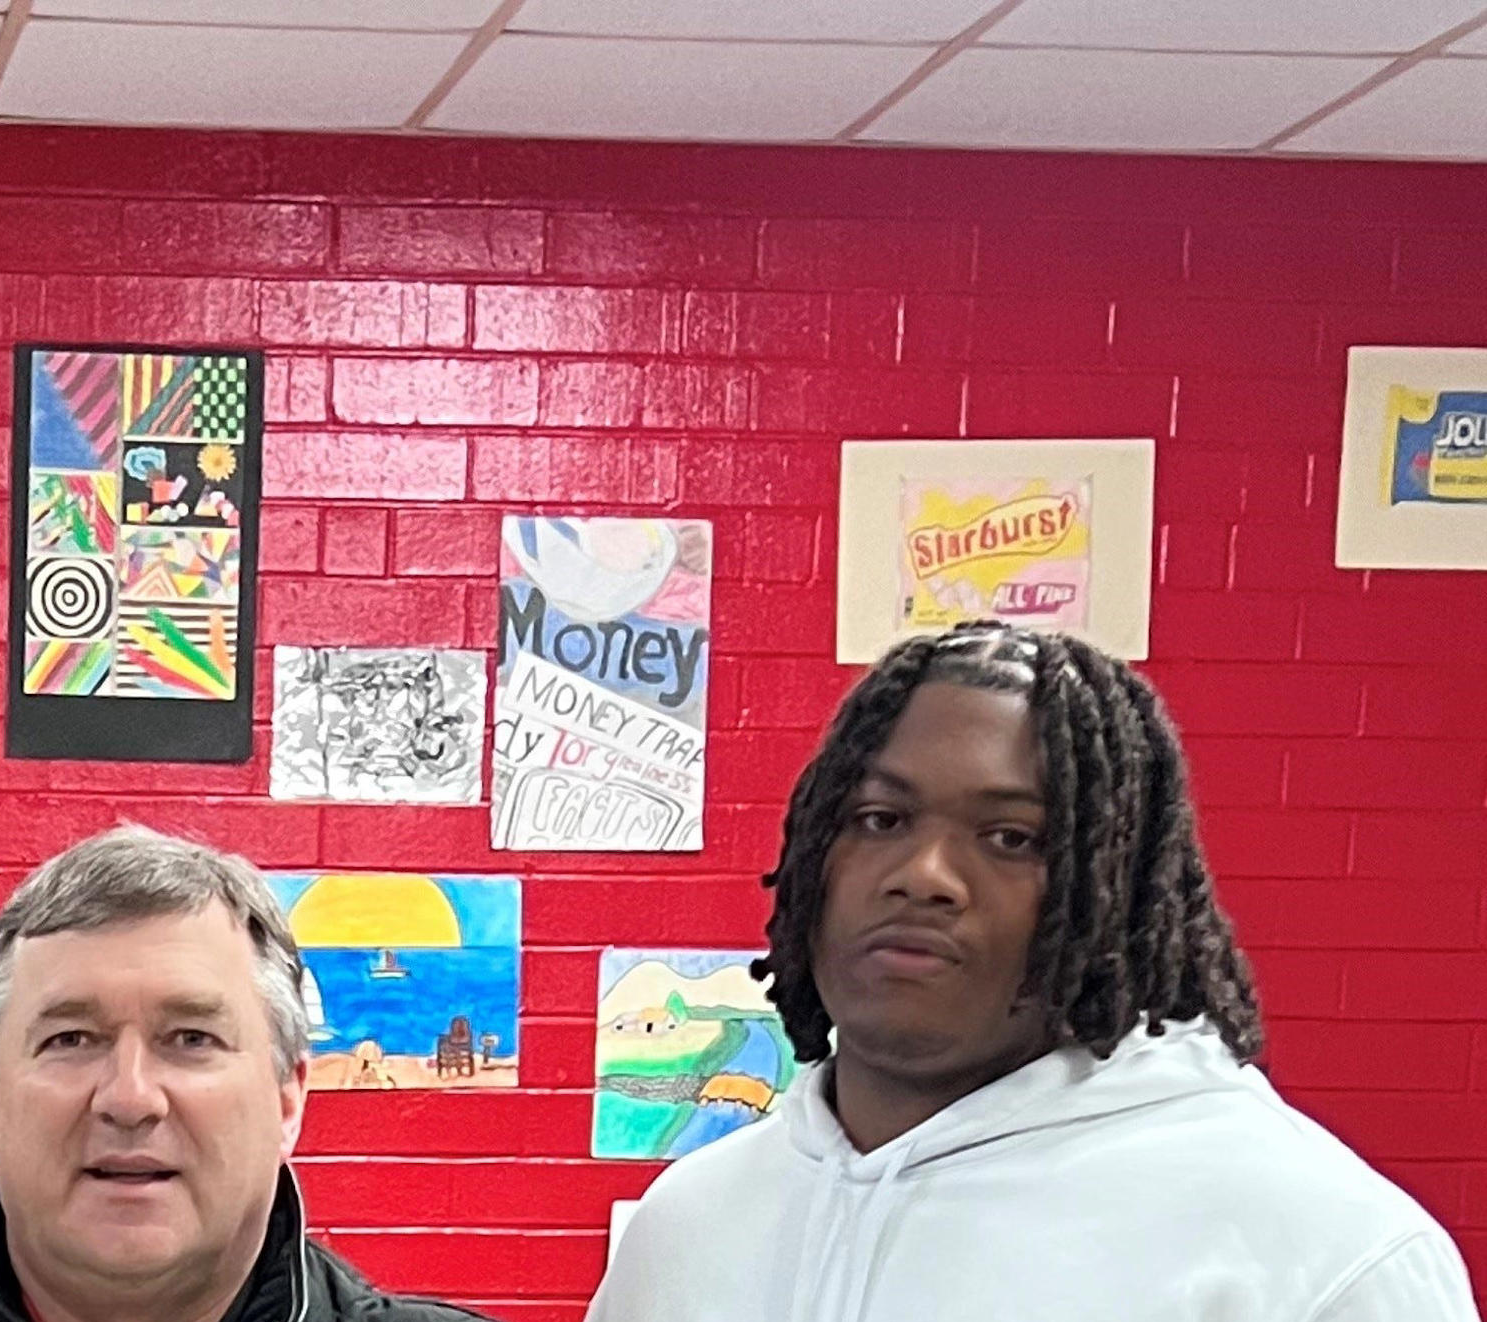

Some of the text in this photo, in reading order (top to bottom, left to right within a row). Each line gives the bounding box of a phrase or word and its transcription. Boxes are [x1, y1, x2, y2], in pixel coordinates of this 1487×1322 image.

[915, 500, 1072, 569] Starburst
[498, 584, 709, 708] Money
[516, 665, 636, 739] MONEY
